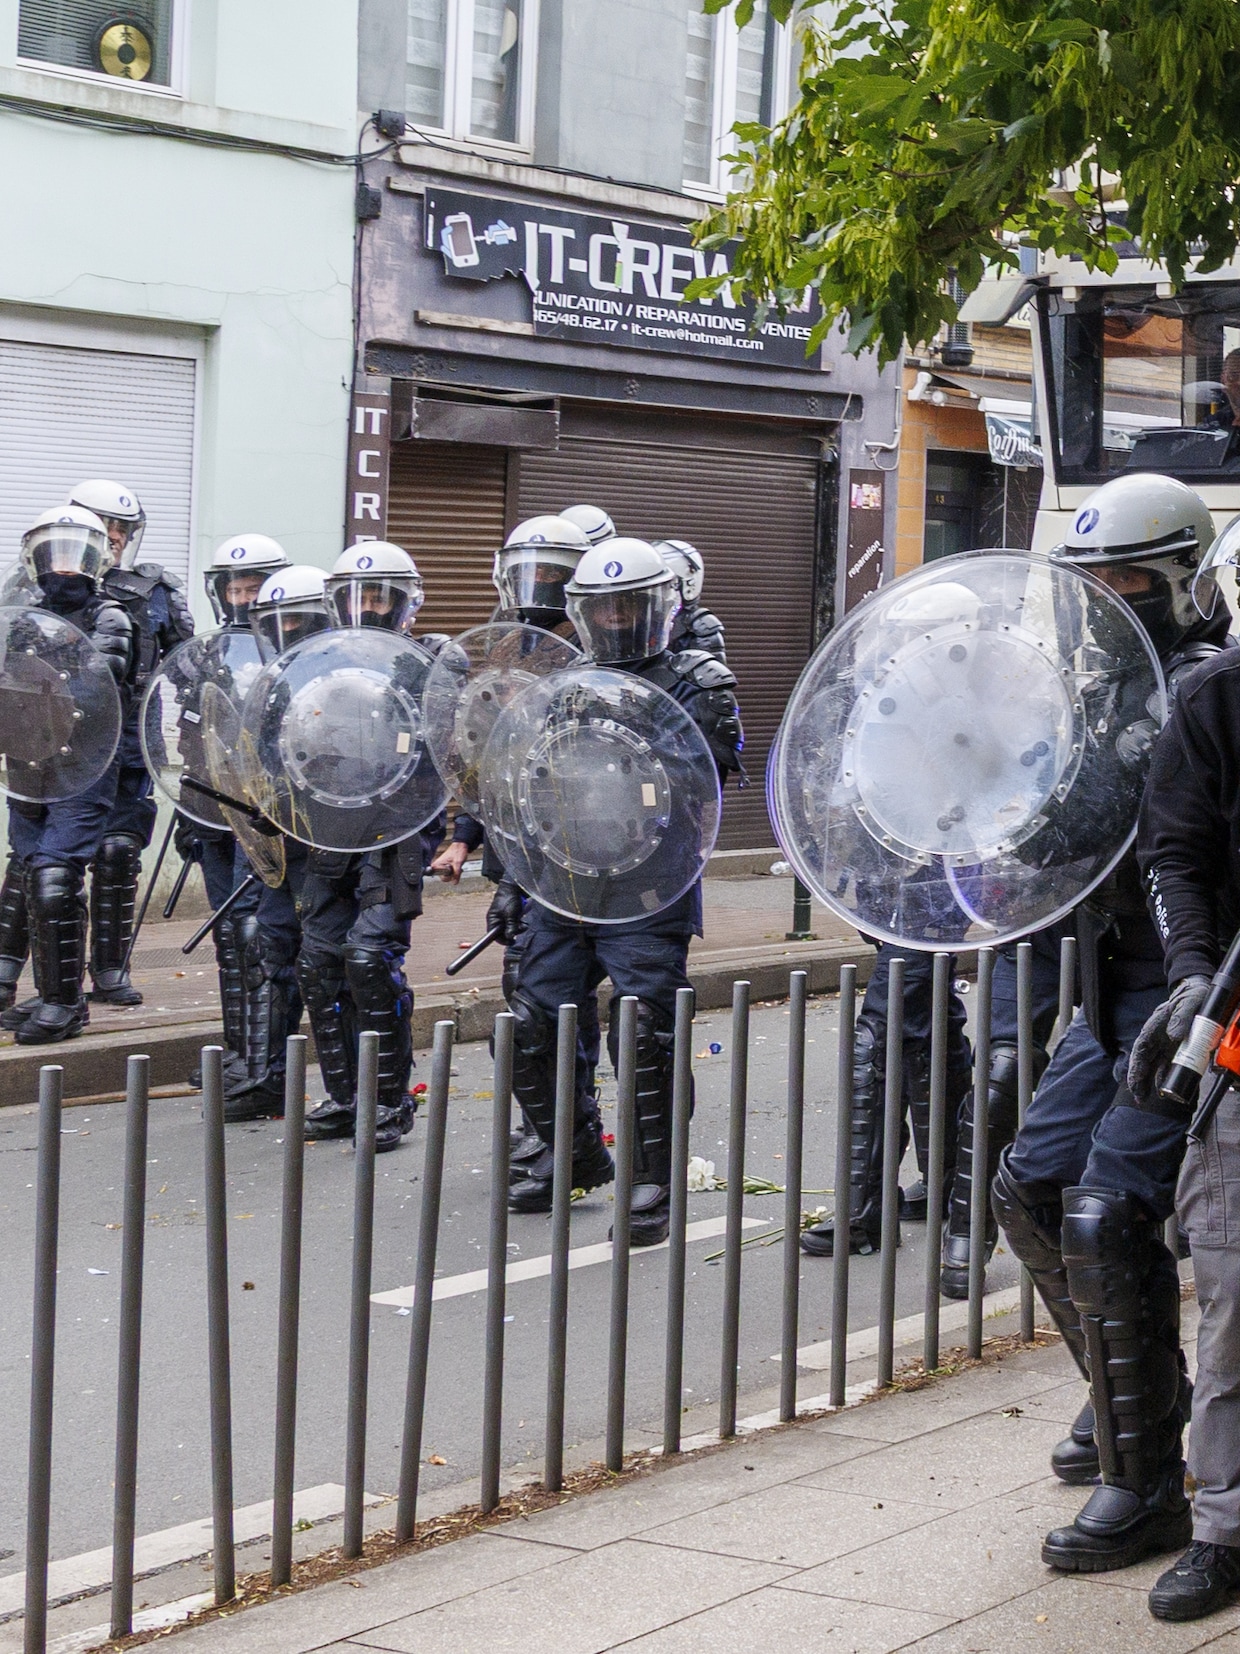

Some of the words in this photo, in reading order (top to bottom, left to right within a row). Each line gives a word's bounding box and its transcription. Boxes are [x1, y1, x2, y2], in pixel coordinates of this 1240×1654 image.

[534, 290, 623, 316] UNICATION
[636, 304, 747, 333] REPARATIONS
[760, 321, 813, 341] VENTES
[631, 322, 764, 351] it-crew@hotmail.com
[355, 406, 388, 435] IT
[848, 540, 881, 578] reparation
